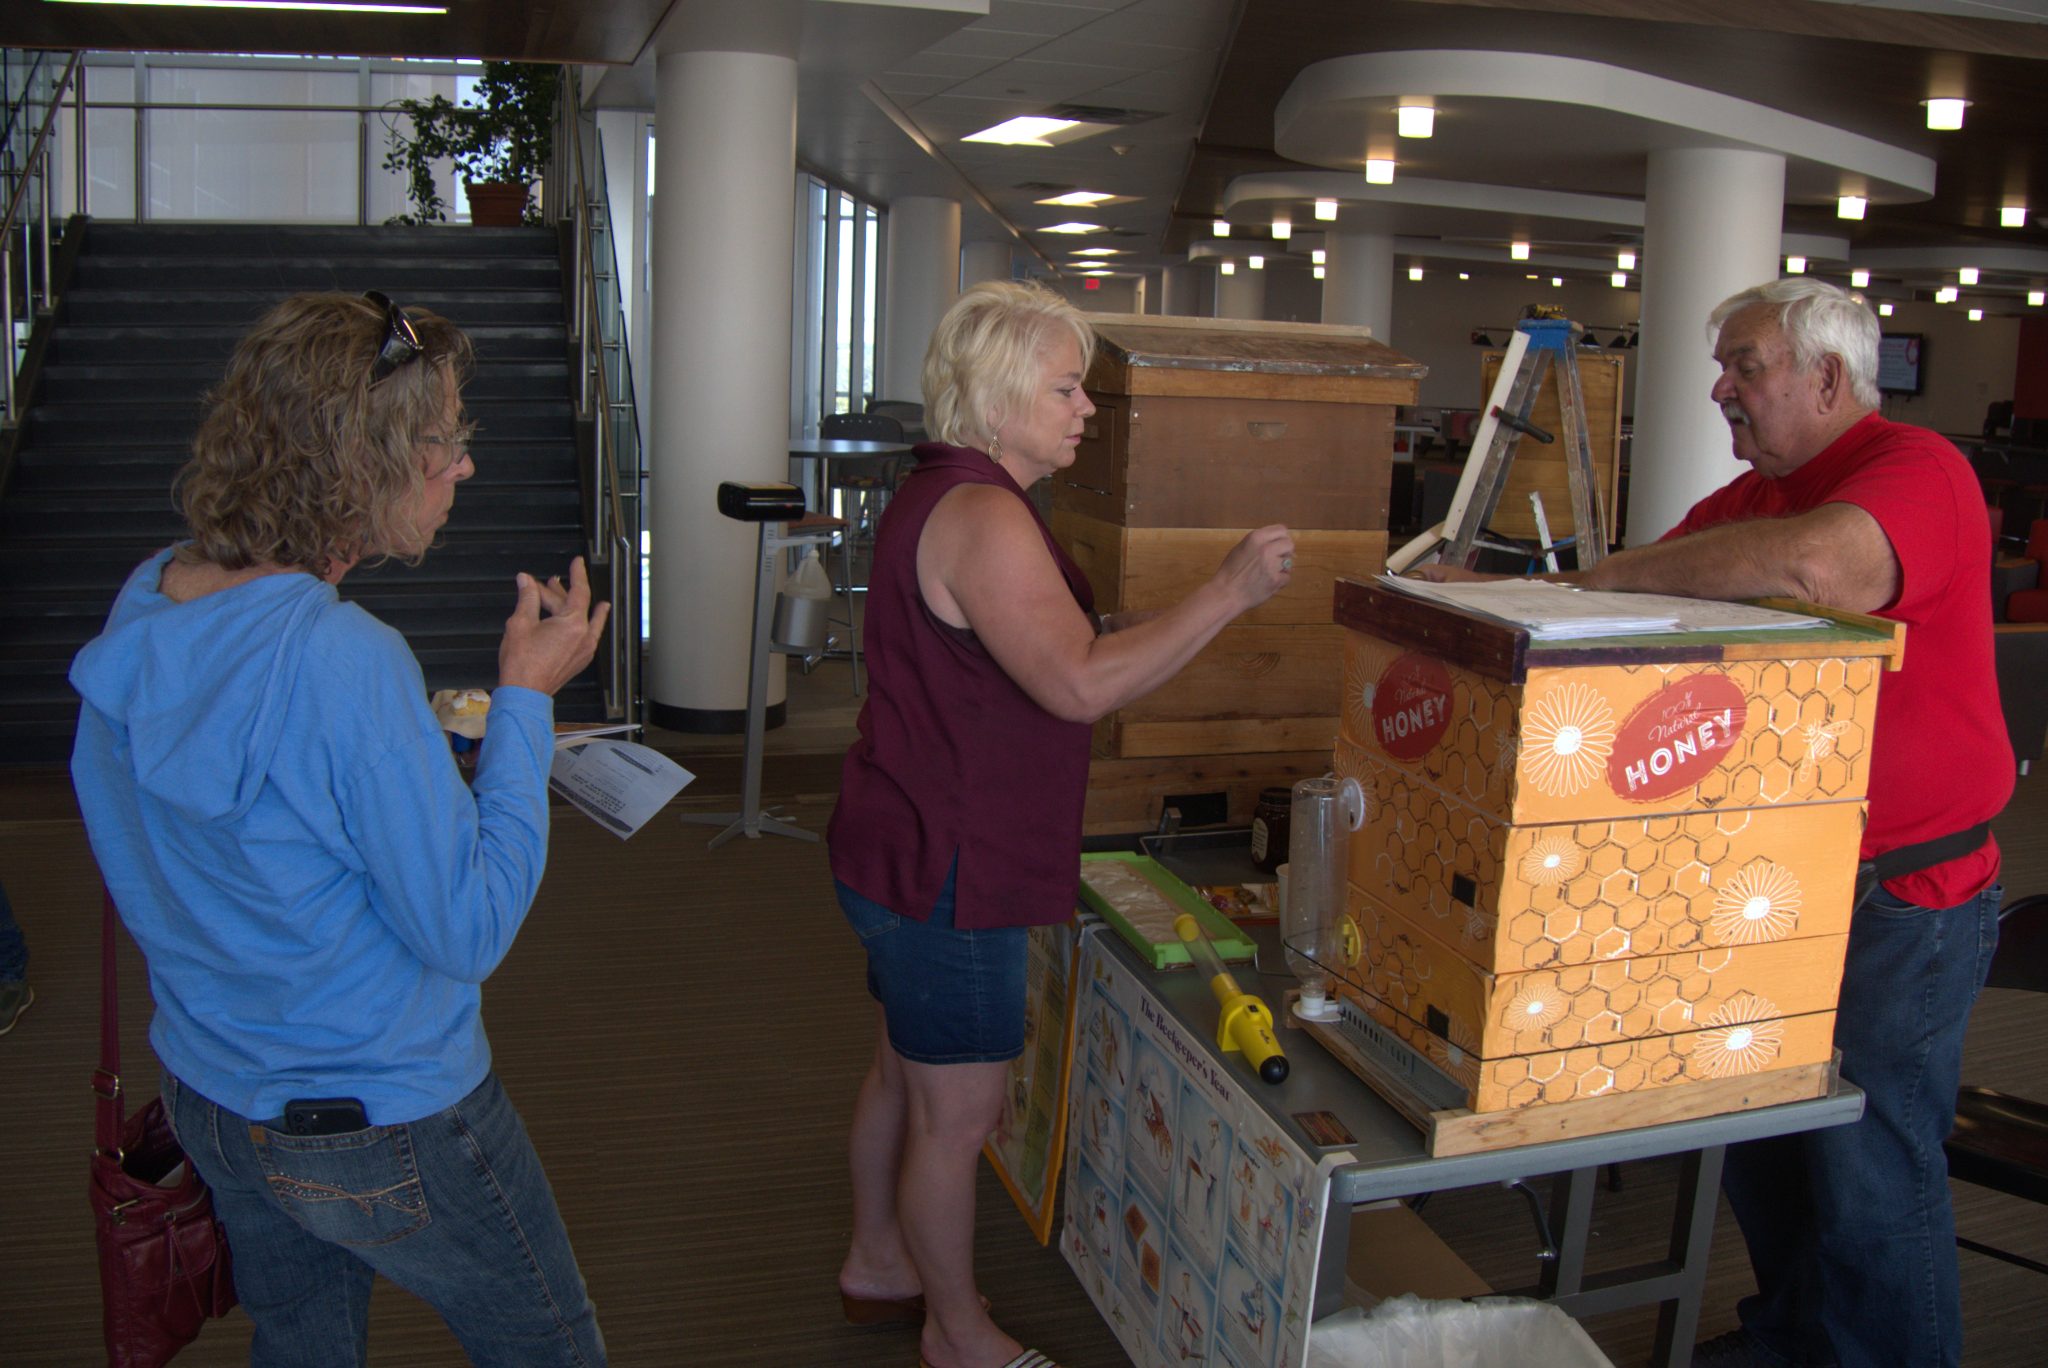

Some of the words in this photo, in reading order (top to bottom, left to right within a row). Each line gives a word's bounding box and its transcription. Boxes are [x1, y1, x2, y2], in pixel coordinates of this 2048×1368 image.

[1382, 693, 1447, 744] HONEY
[1625, 708, 1732, 791] HONEY
[1648, 702, 1702, 742] Natural
[1140, 995, 1156, 1025] The
[1156, 1011, 1208, 1079] Beekeeper's
[1209, 1069, 1232, 1102] Year
